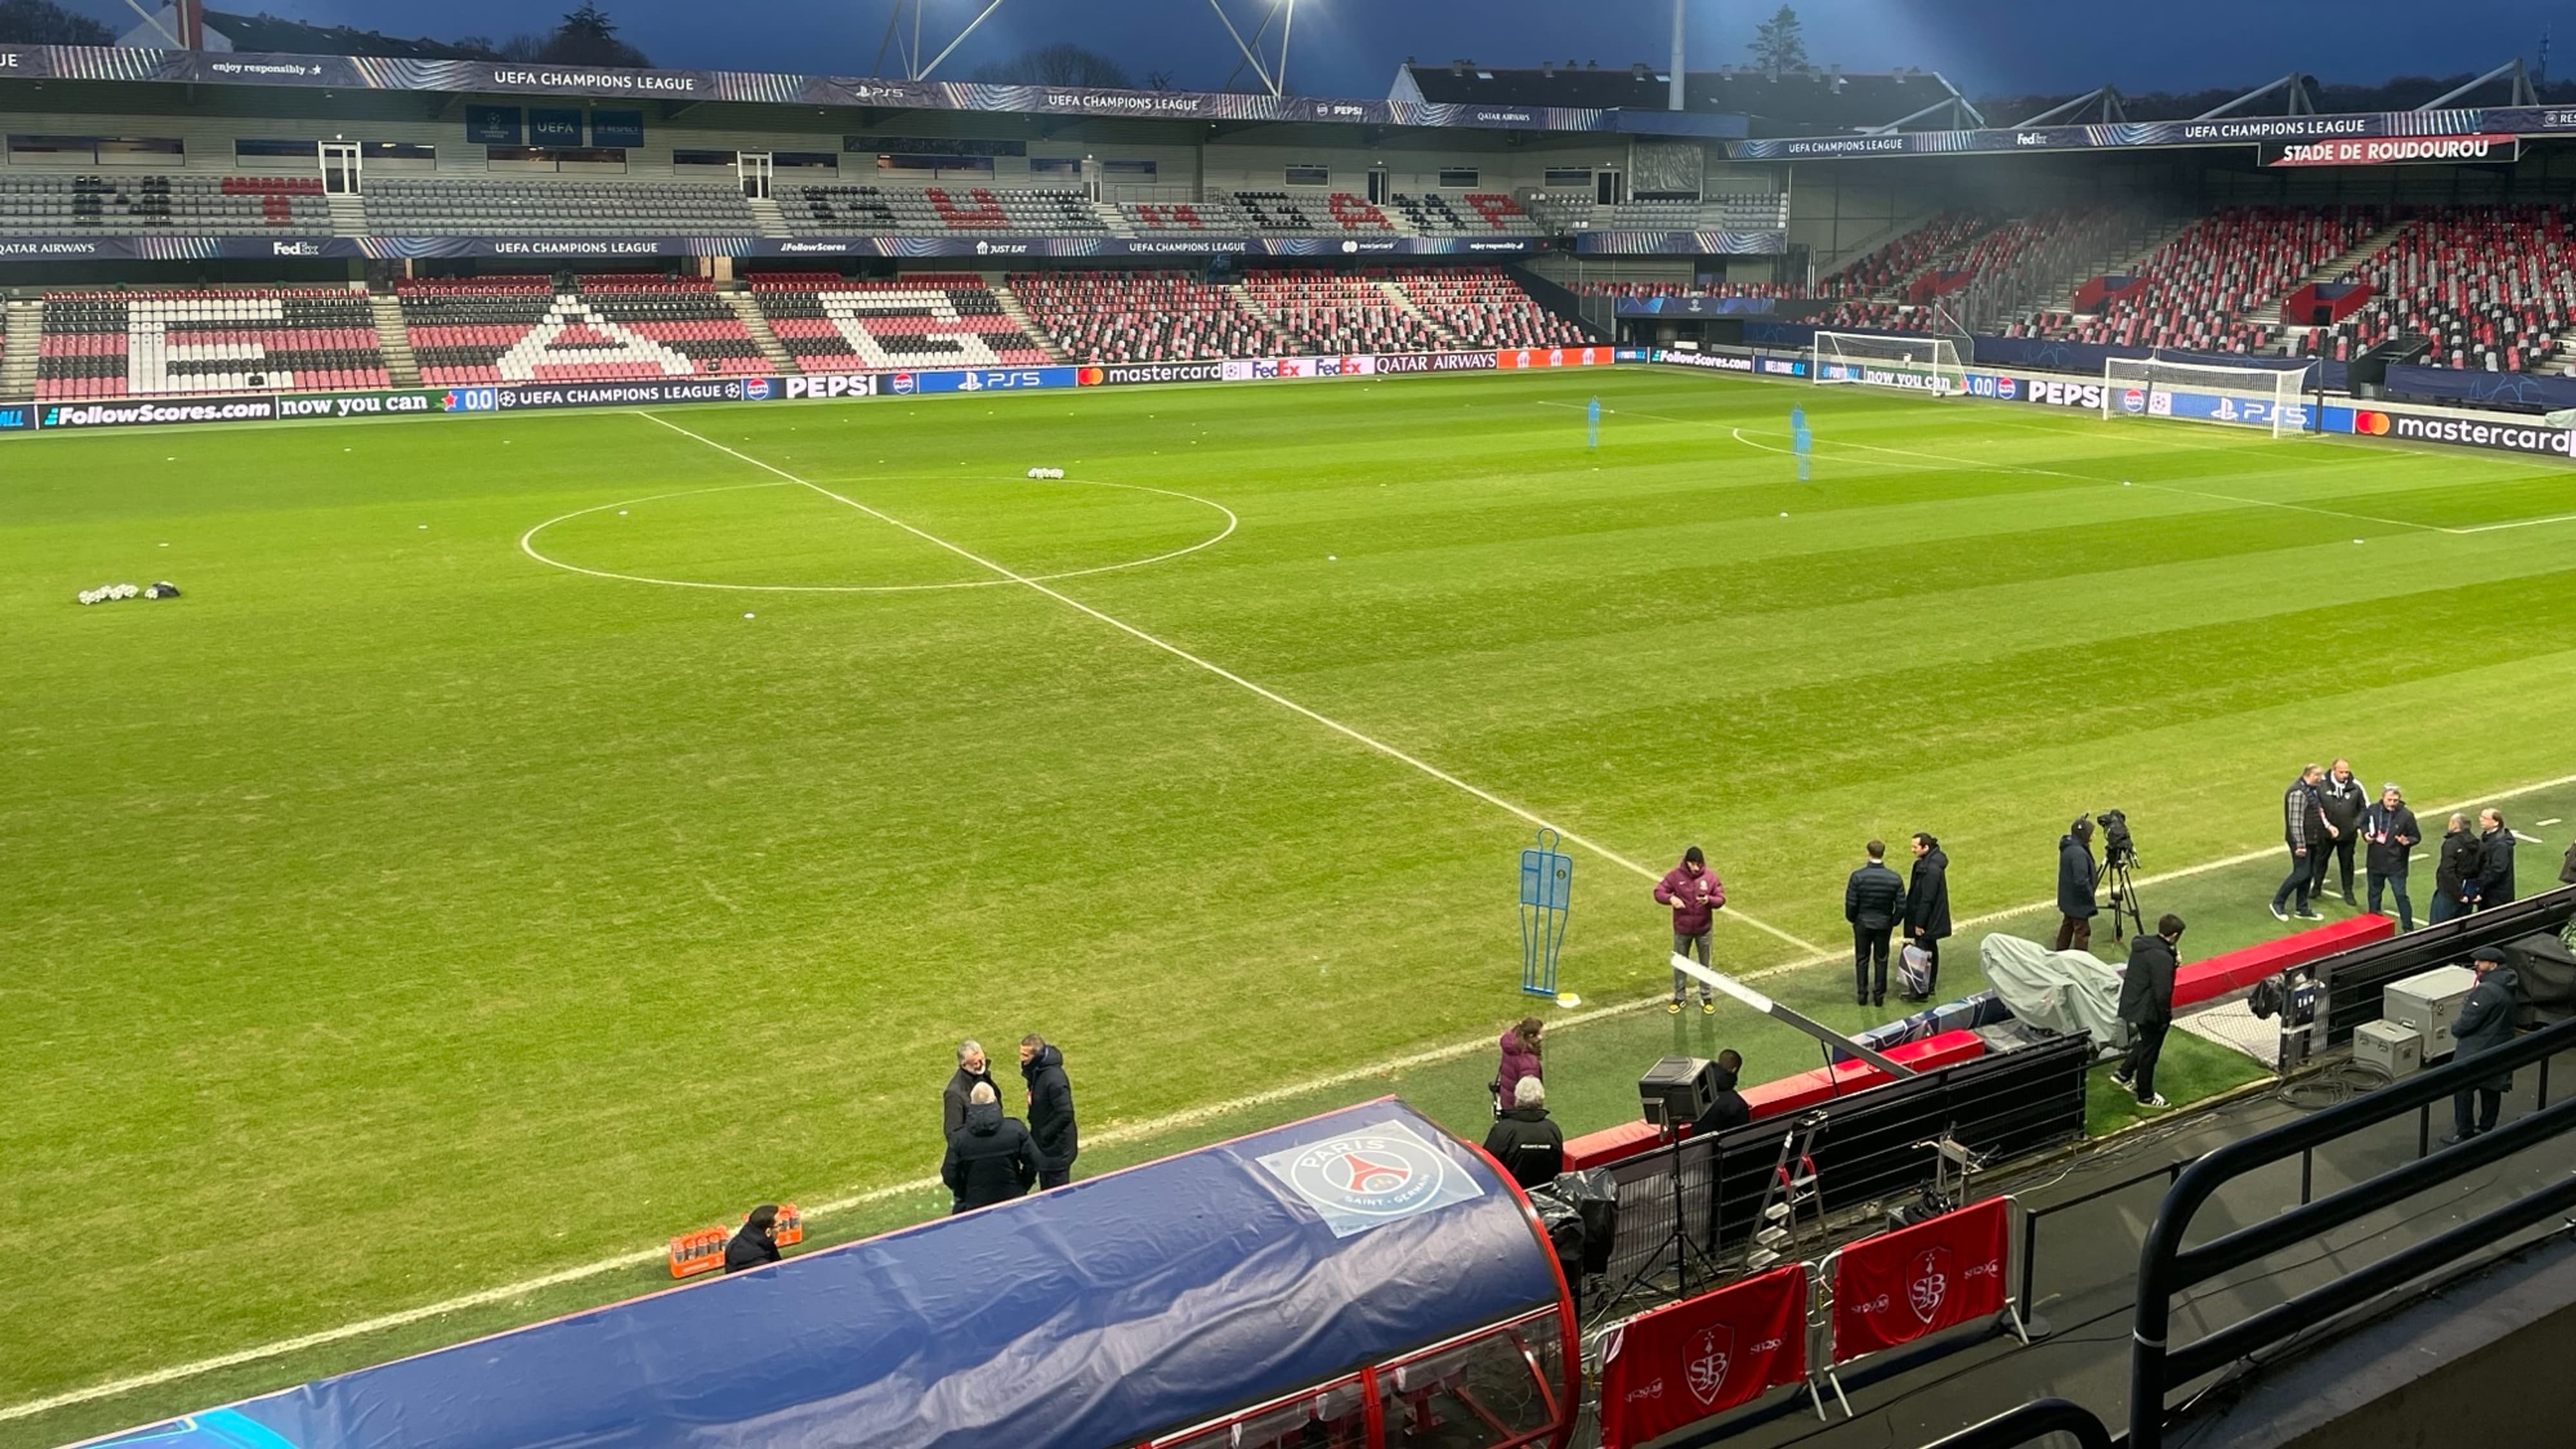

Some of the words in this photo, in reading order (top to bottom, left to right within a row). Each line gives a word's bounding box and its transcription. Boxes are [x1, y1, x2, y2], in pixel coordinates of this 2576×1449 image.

[212, 63, 242, 73] enjoy
[244, 64, 305, 75] responsibly
[494, 71, 536, 84] UEFA
[540, 73, 632, 88] CHAMPIONS
[637, 77, 694, 90] LEAGUE
[872, 88, 904, 97] PS5
[1048, 94, 1080, 106] UEFA
[1083, 96, 1152, 109] CHAMPIONS
[1155, 99, 1198, 111] LEAGUE
[1334, 105, 1363, 115] PEPSI
[1477, 111, 1501, 121] QATAR
[537, 122, 574, 133] UEFA
[2185, 126, 2217, 137] UEFA
[2221, 122, 2304, 137] CHAMPIONS
[2308, 120, 2365, 134] LEAGUE
[1789, 143, 1810, 153] UEFA
[1812, 141, 1865, 153] CHAMPIONS
[1867, 139, 1902, 149] LEAGUE
[2017, 132, 2047, 145] FedEx
[2283, 144, 2334, 162] STADE
[2340, 143, 2362, 160] DE
[2370, 140, 2489, 160] ROUDOUROU
[41, 243, 95, 252] AIRWAYS
[272, 242, 319, 255] FedEx
[495, 242, 529, 253] UEFA
[533, 242, 607, 253] CHAMPIONS
[611, 242, 658, 252] LEAGUE
[786, 242, 846, 252] FollowScores
[990, 245, 1010, 254] JUST
[1129, 242, 1154, 252] UEFA
[1155, 242, 1209, 252] CHAMPIONS
[1211, 242, 1245, 252] LEAGUE
[1252, 359, 1300, 378] FedEx
[1316, 357, 1362, 376] FedEx
[1376, 355, 1428, 373] QATAR
[1434, 353, 1497, 370] AIRWAYS
[1661, 350, 1752, 370] FollowScores.com
[987, 372, 1040, 387] PS5
[1109, 363, 1222, 383] mastercard
[1868, 371, 1894, 382] now
[1897, 374, 1922, 386] you
[520, 388, 563, 404] UEFA
[567, 386, 659, 402] CHAMPIONS
[664, 384, 721, 400] LEAGUE
[786, 375, 877, 399] PEPSI
[2029, 381, 2107, 409] PEPSI
[281, 399, 333, 415] now
[337, 397, 381, 417] you
[386, 395, 428, 411] can
[465, 390, 493, 410] 0.0
[58, 401, 270, 425] FollowScores.com
[2397, 418, 2571, 453] mastercard
[1300, 1138, 1387, 1170] PARIS
[1343, 1195, 1383, 1207] SAINT
[1394, 1173, 1431, 1204] GERMAIN
[1912, 1273, 1946, 1304] SB
[1689, 1352, 1727, 1383] SB
